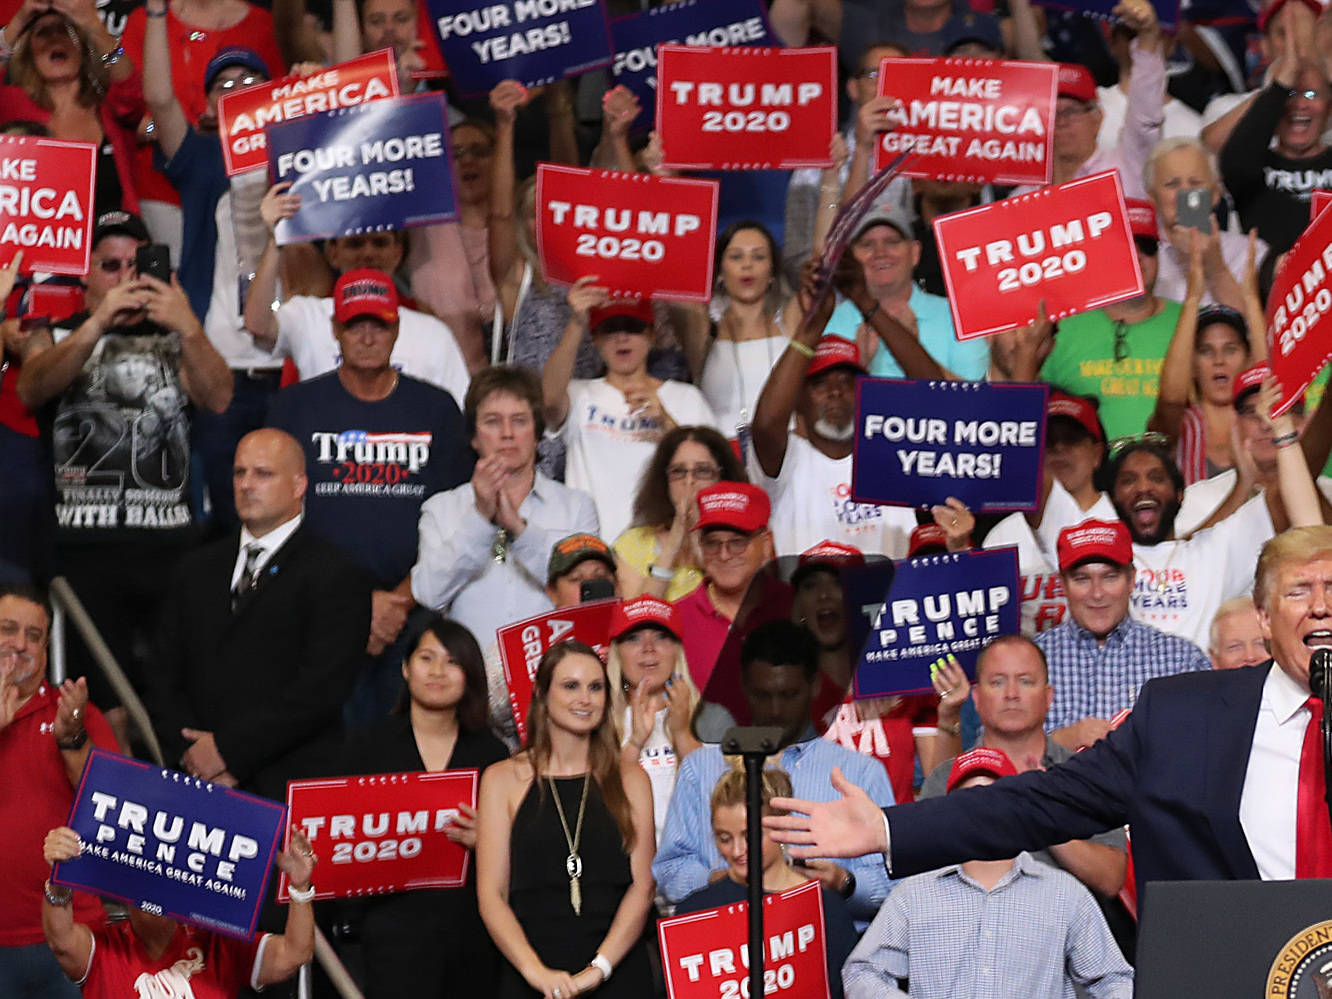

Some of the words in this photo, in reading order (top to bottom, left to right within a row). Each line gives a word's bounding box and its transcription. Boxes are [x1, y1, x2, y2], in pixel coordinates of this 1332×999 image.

[437, 4, 512, 40] FOUR
[471, 21, 572, 64] YEARS!
[612, 40, 680, 76] FOU
[685, 16, 767, 47] MORE
[271, 69, 340, 101] MAKE
[670, 81, 823, 107] TRUMP
[930, 76, 1003, 99] MAKE
[230, 76, 391, 136] AMERICA
[701, 111, 791, 133] 2020
[886, 99, 1045, 137] AMERICA
[277, 144, 357, 178] FOUR
[360, 133, 444, 165] MORE
[882, 133, 963, 157] GREAT
[964, 138, 1045, 163] AGAIN
[0, 157, 37, 181] KE
[312, 168, 415, 202] YEARS!
[0, 184, 84, 221] RICA
[548, 201, 701, 237] TRUMP
[0, 222, 83, 250] AGAIN
[575, 234, 666, 261] 2020
[956, 210, 1114, 274] TRUMP
[997, 248, 1088, 291] 2020
[1279, 288, 1332, 356] 2020
[864, 414, 948, 444] FOUR
[953, 420, 1038, 448] MORE
[311, 431, 432, 475] Trump
[896, 450, 1002, 479] YEARS!
[341, 460, 402, 485] 2020
[55, 502, 119, 528] WITH
[861, 586, 1010, 630] TRUMP
[879, 615, 1001, 648] PENCE
[521, 624, 547, 683] GRE
[91, 790, 259, 863] TRUMP
[302, 808, 461, 840] TRUMP
[96, 824, 236, 882] PENCE
[331, 837, 423, 864] 2020
[110, 850, 163, 877] AMERICA
[165, 866, 204, 888] GREAT
[139, 899, 163, 917] 2020
